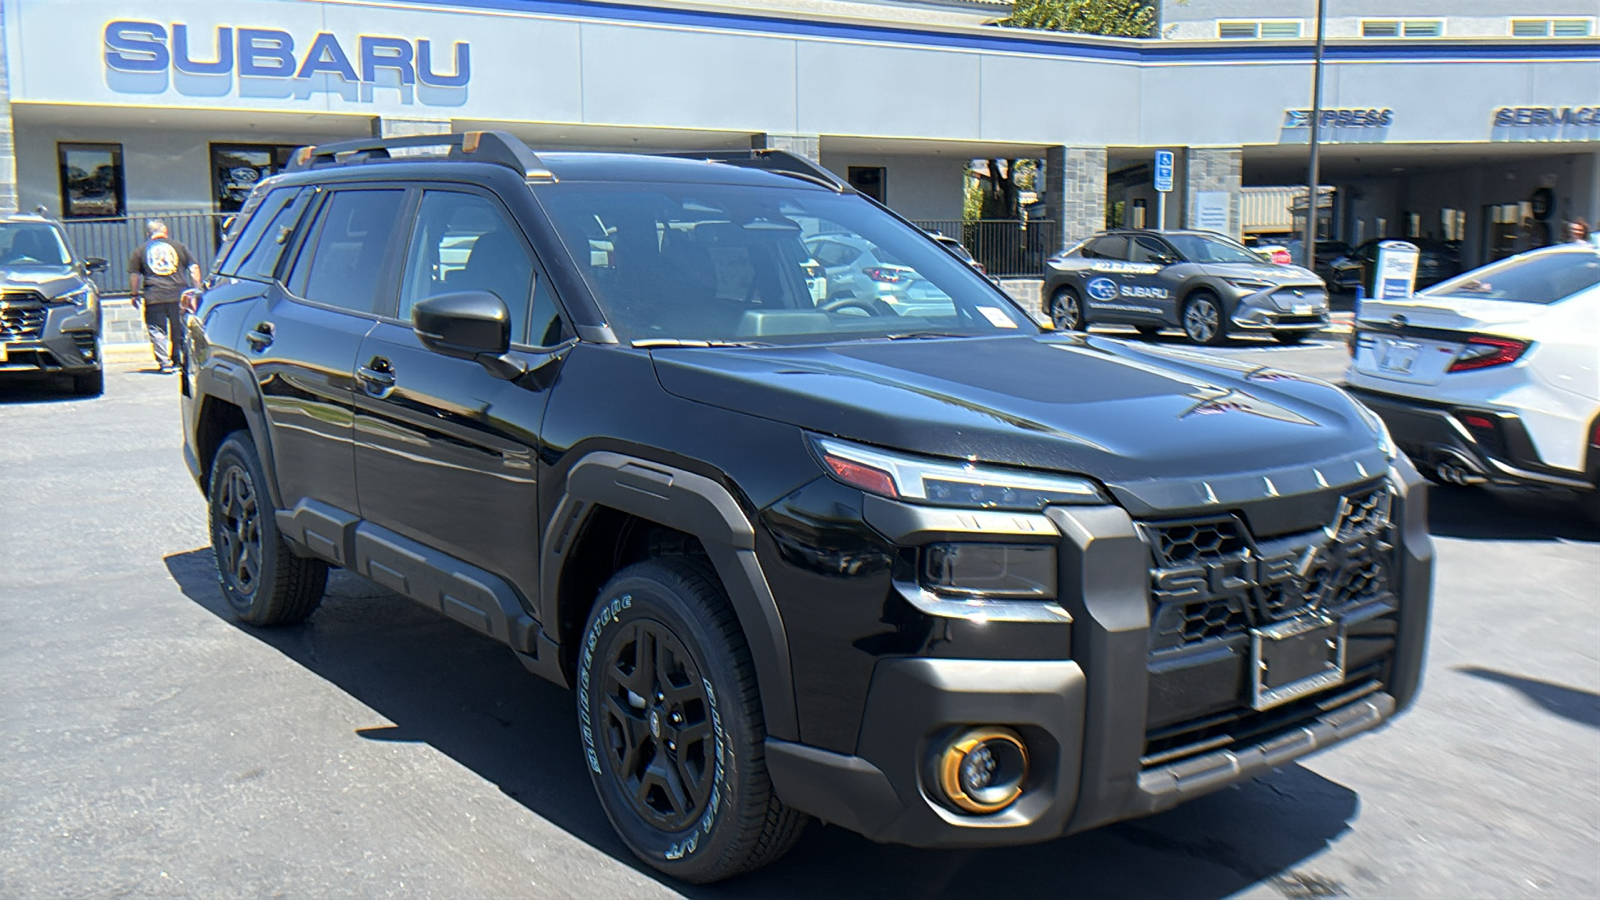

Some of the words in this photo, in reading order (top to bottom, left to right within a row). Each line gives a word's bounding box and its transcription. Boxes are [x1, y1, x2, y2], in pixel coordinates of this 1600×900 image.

[104, 19, 471, 88] SUBARU
[1284, 107, 1394, 127] EPRESS
[1120, 285, 1169, 299] SUBARU
